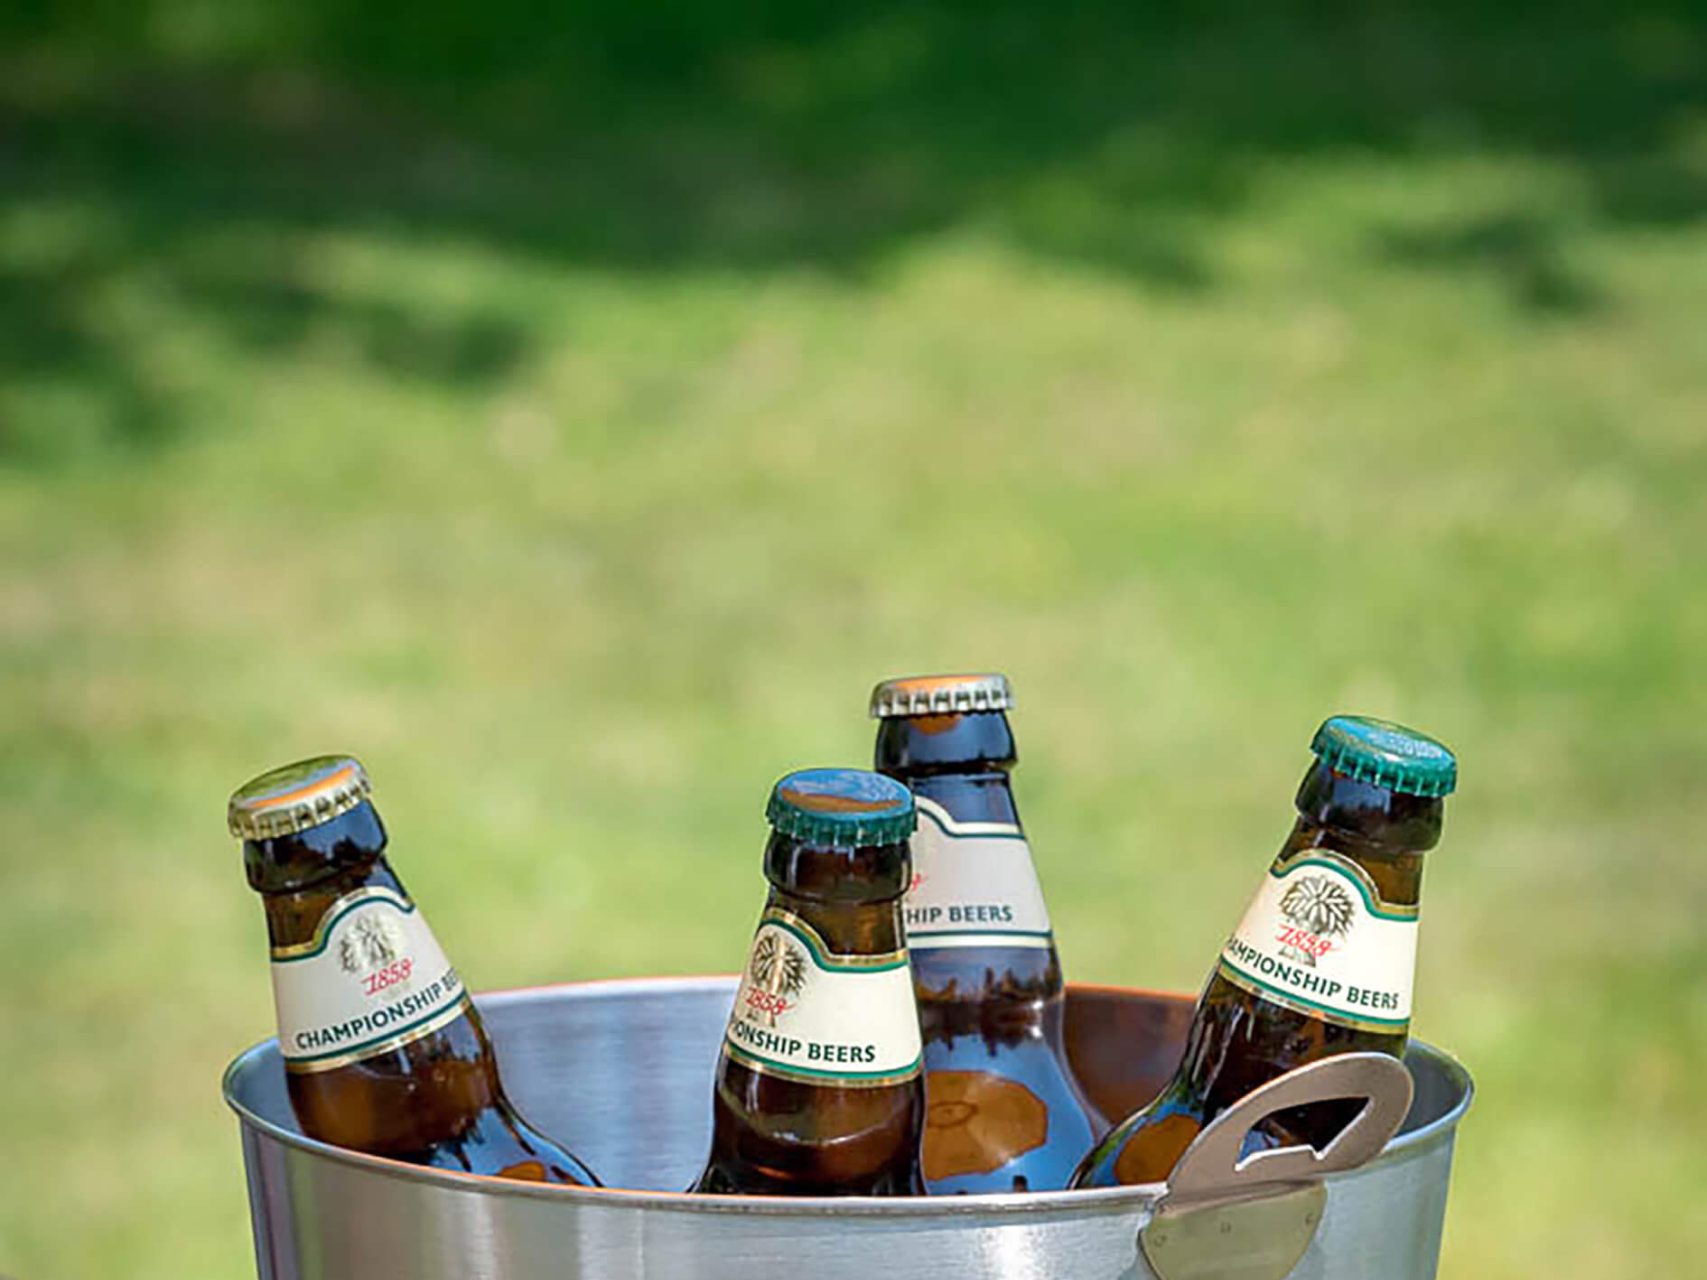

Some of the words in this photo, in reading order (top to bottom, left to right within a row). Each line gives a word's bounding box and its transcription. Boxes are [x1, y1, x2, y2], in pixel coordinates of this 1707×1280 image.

[948, 906, 1013, 922] BEERS
[360, 956, 413, 996] 1858
[1346, 986, 1399, 1010] BEERS
[295, 982, 441, 1050] CHAMPIONSHIP
[807, 1043, 875, 1063] BEERS
